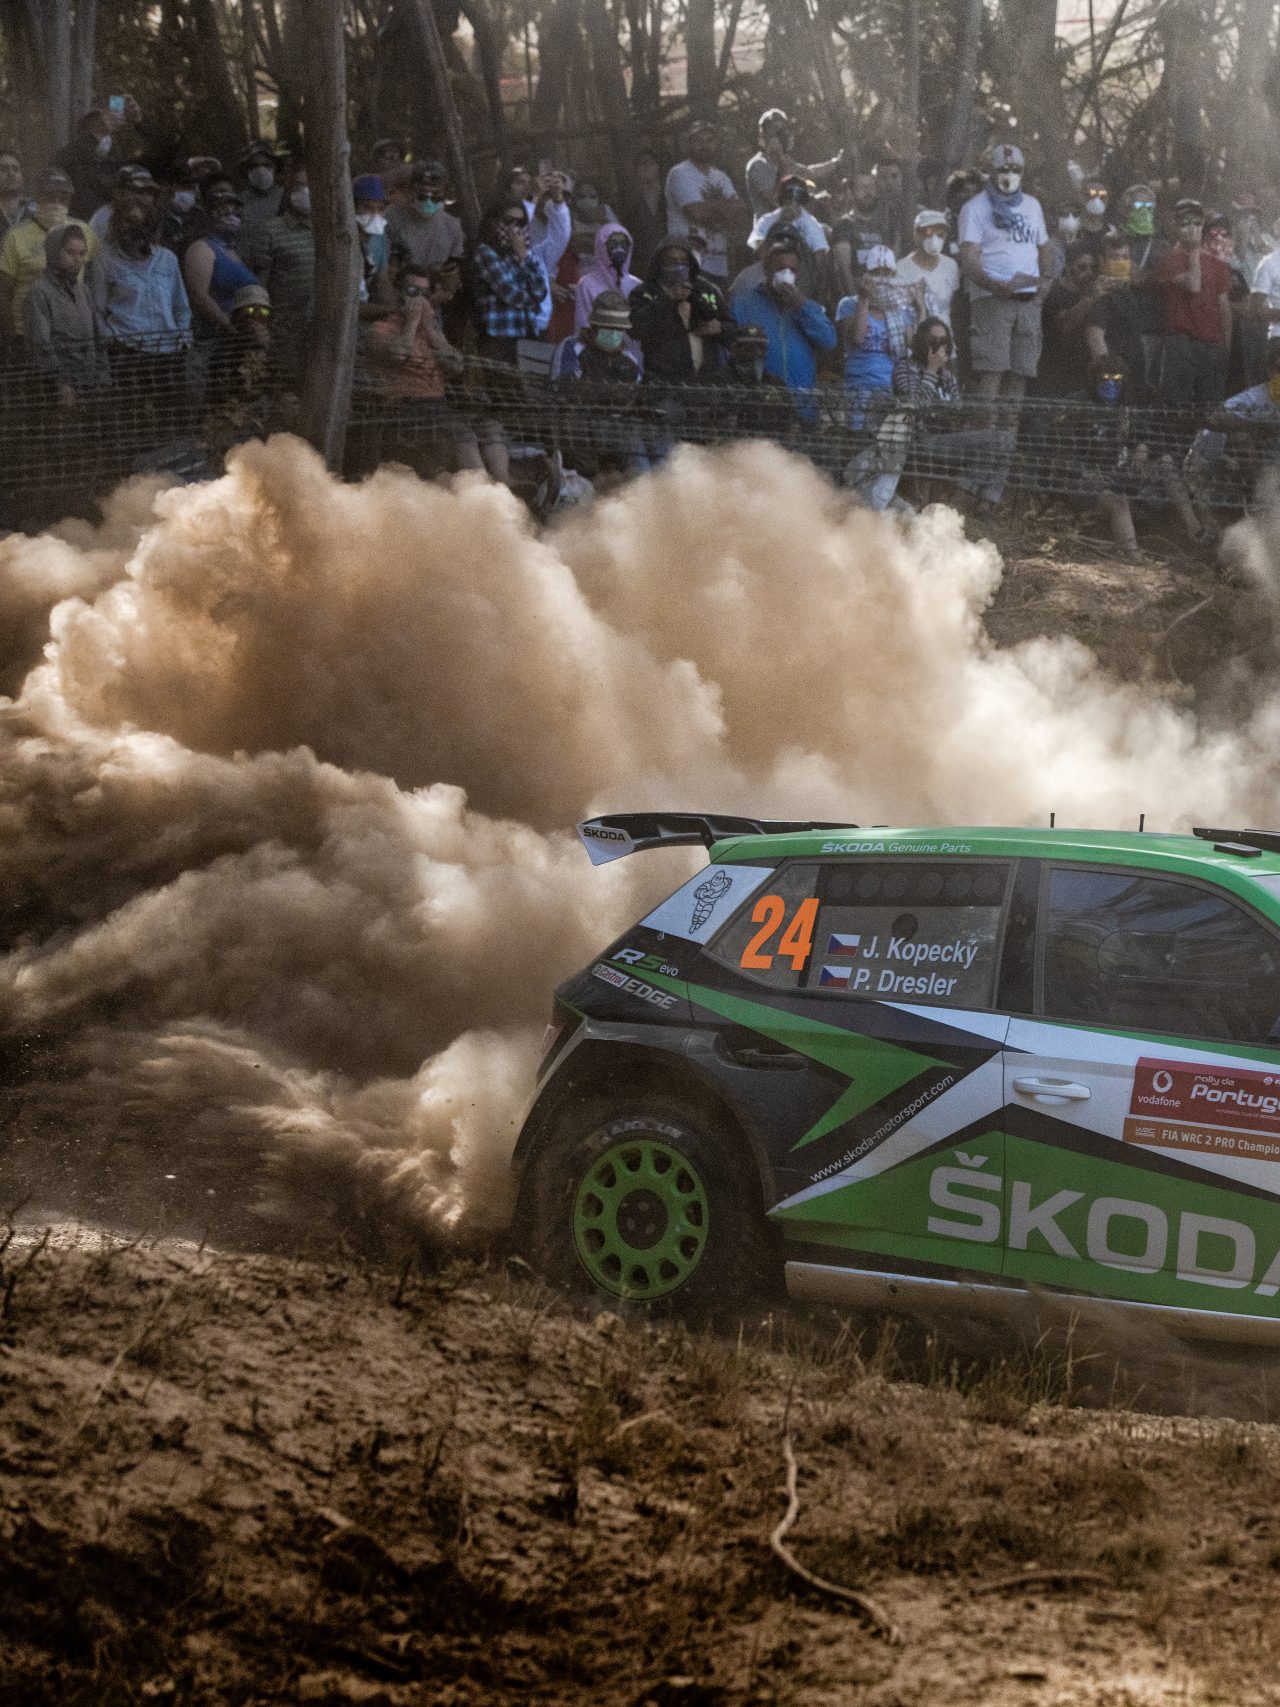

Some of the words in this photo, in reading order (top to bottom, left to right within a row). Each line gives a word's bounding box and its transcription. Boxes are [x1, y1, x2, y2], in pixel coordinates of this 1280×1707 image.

[583, 827, 627, 842] ŠKODA
[821, 842, 885, 853] ŠKODA
[888, 842, 936, 853] Genuine
[939, 842, 972, 853] Parts
[739, 894, 820, 971] 24
[862, 936, 880, 960] J.
[886, 936, 979, 970] Kopecký
[660, 964, 679, 977] evo
[599, 967, 626, 987] Castrol
[621, 978, 679, 1010] EDGE
[852, 968, 871, 991] P.
[876, 969, 958, 996] Dresler
[1194, 1075, 1221, 1087] rally
[1221, 1078, 1236, 1087] de
[1138, 1095, 1182, 1108] vodafone
[810, 1074, 955, 1184] www.skoda-motorsport.com
[1161, 1129, 1178, 1141] FIA
[1181, 1131, 1204, 1145] WRC
[1204, 1135, 1212, 1146] 2
[1214, 1137, 1235, 1149] PRO
